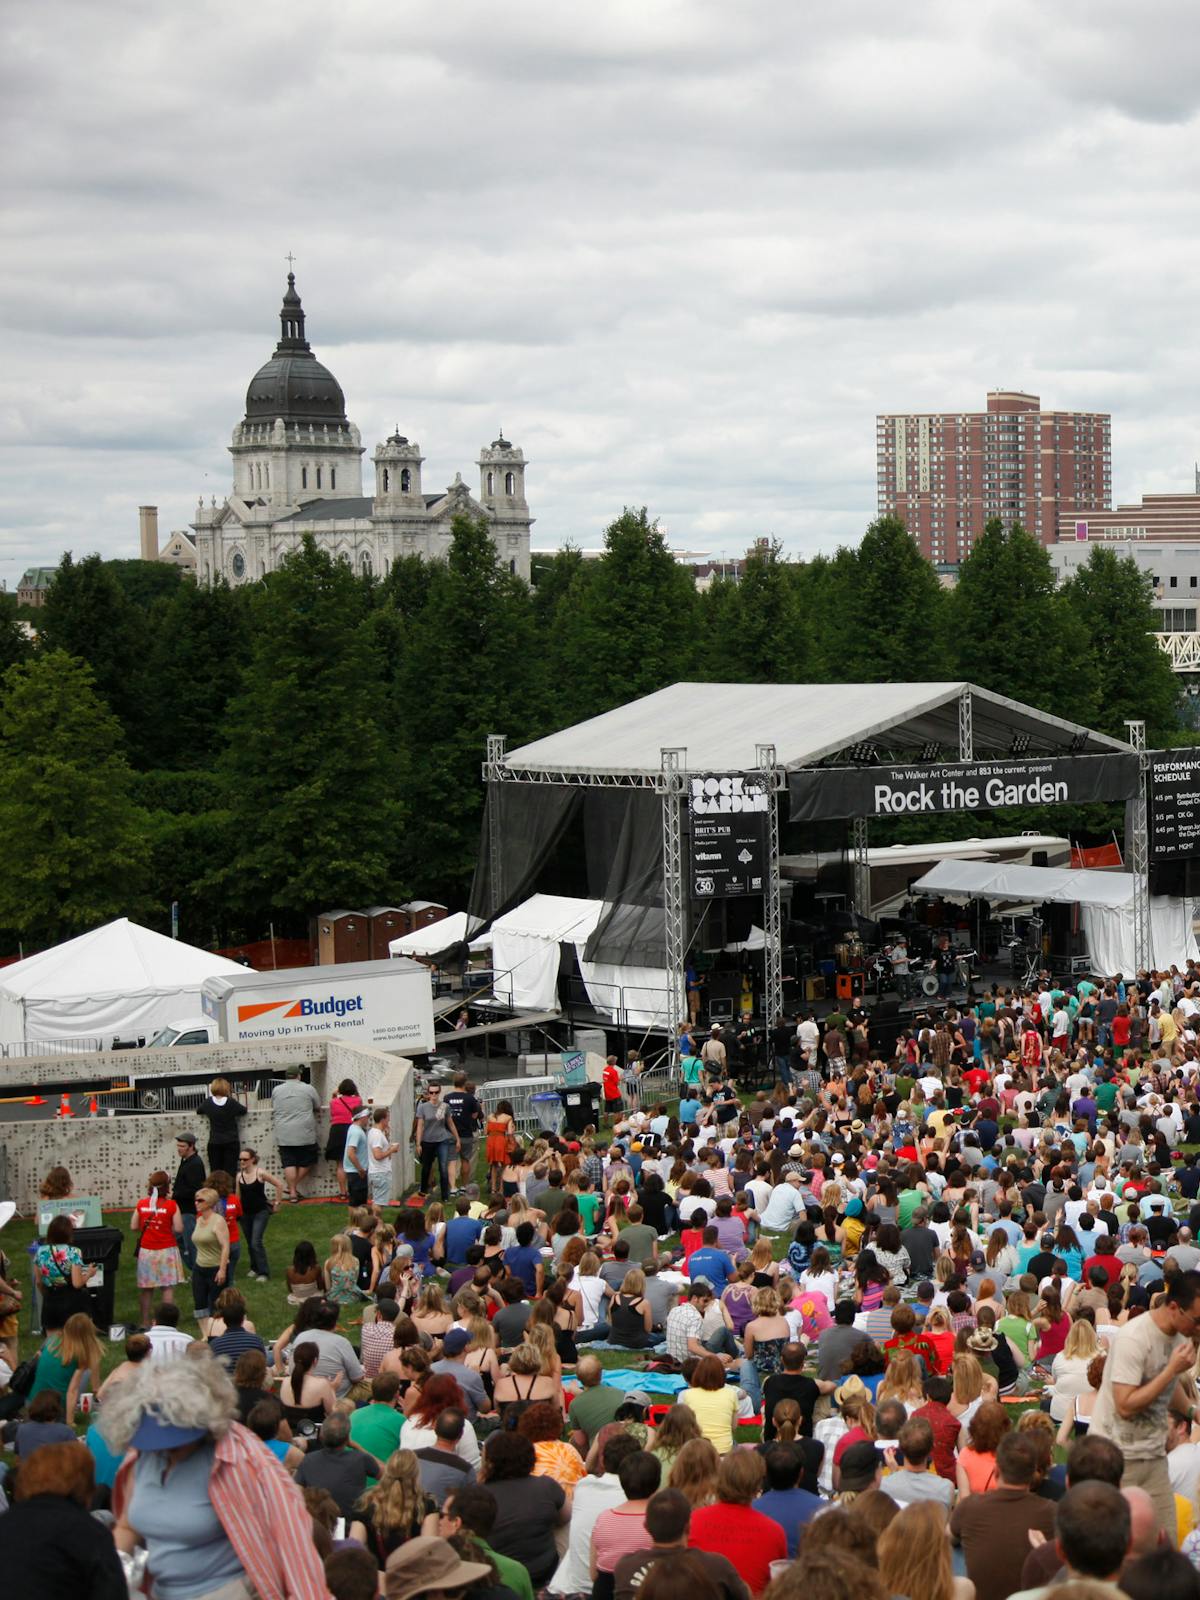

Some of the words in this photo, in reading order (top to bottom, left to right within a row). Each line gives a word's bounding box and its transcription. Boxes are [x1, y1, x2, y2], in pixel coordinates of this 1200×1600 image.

[891, 771, 904, 780] The
[905, 770, 929, 780] Walker
[930, 769, 940, 778] Art
[941, 768, 964, 778] Center
[966, 768, 977, 776] and
[993, 766, 1003, 775] the
[1028, 764, 1053, 774] present
[1154, 772, 1191, 783] SCHEDULE
[692, 777, 744, 797] ROCK
[874, 783, 936, 813] Rock
[940, 781, 980, 809] the
[985, 776, 1068, 807] Garden
[692, 794, 768, 815] GARDEN
[694, 826, 716, 834] BRIT'S
[700, 881, 712, 891] 50
[300, 995, 363, 1017] Budget
[238, 1028, 275, 1039] Moving
[278, 1027, 291, 1036] Up
[294, 1025, 303, 1033] in
[305, 1021, 331, 1032] Truck
[334, 1018, 365, 1028] Rental
[373, 1032, 421, 1040] www.budget.com
[638, 1133, 655, 1147] 77
